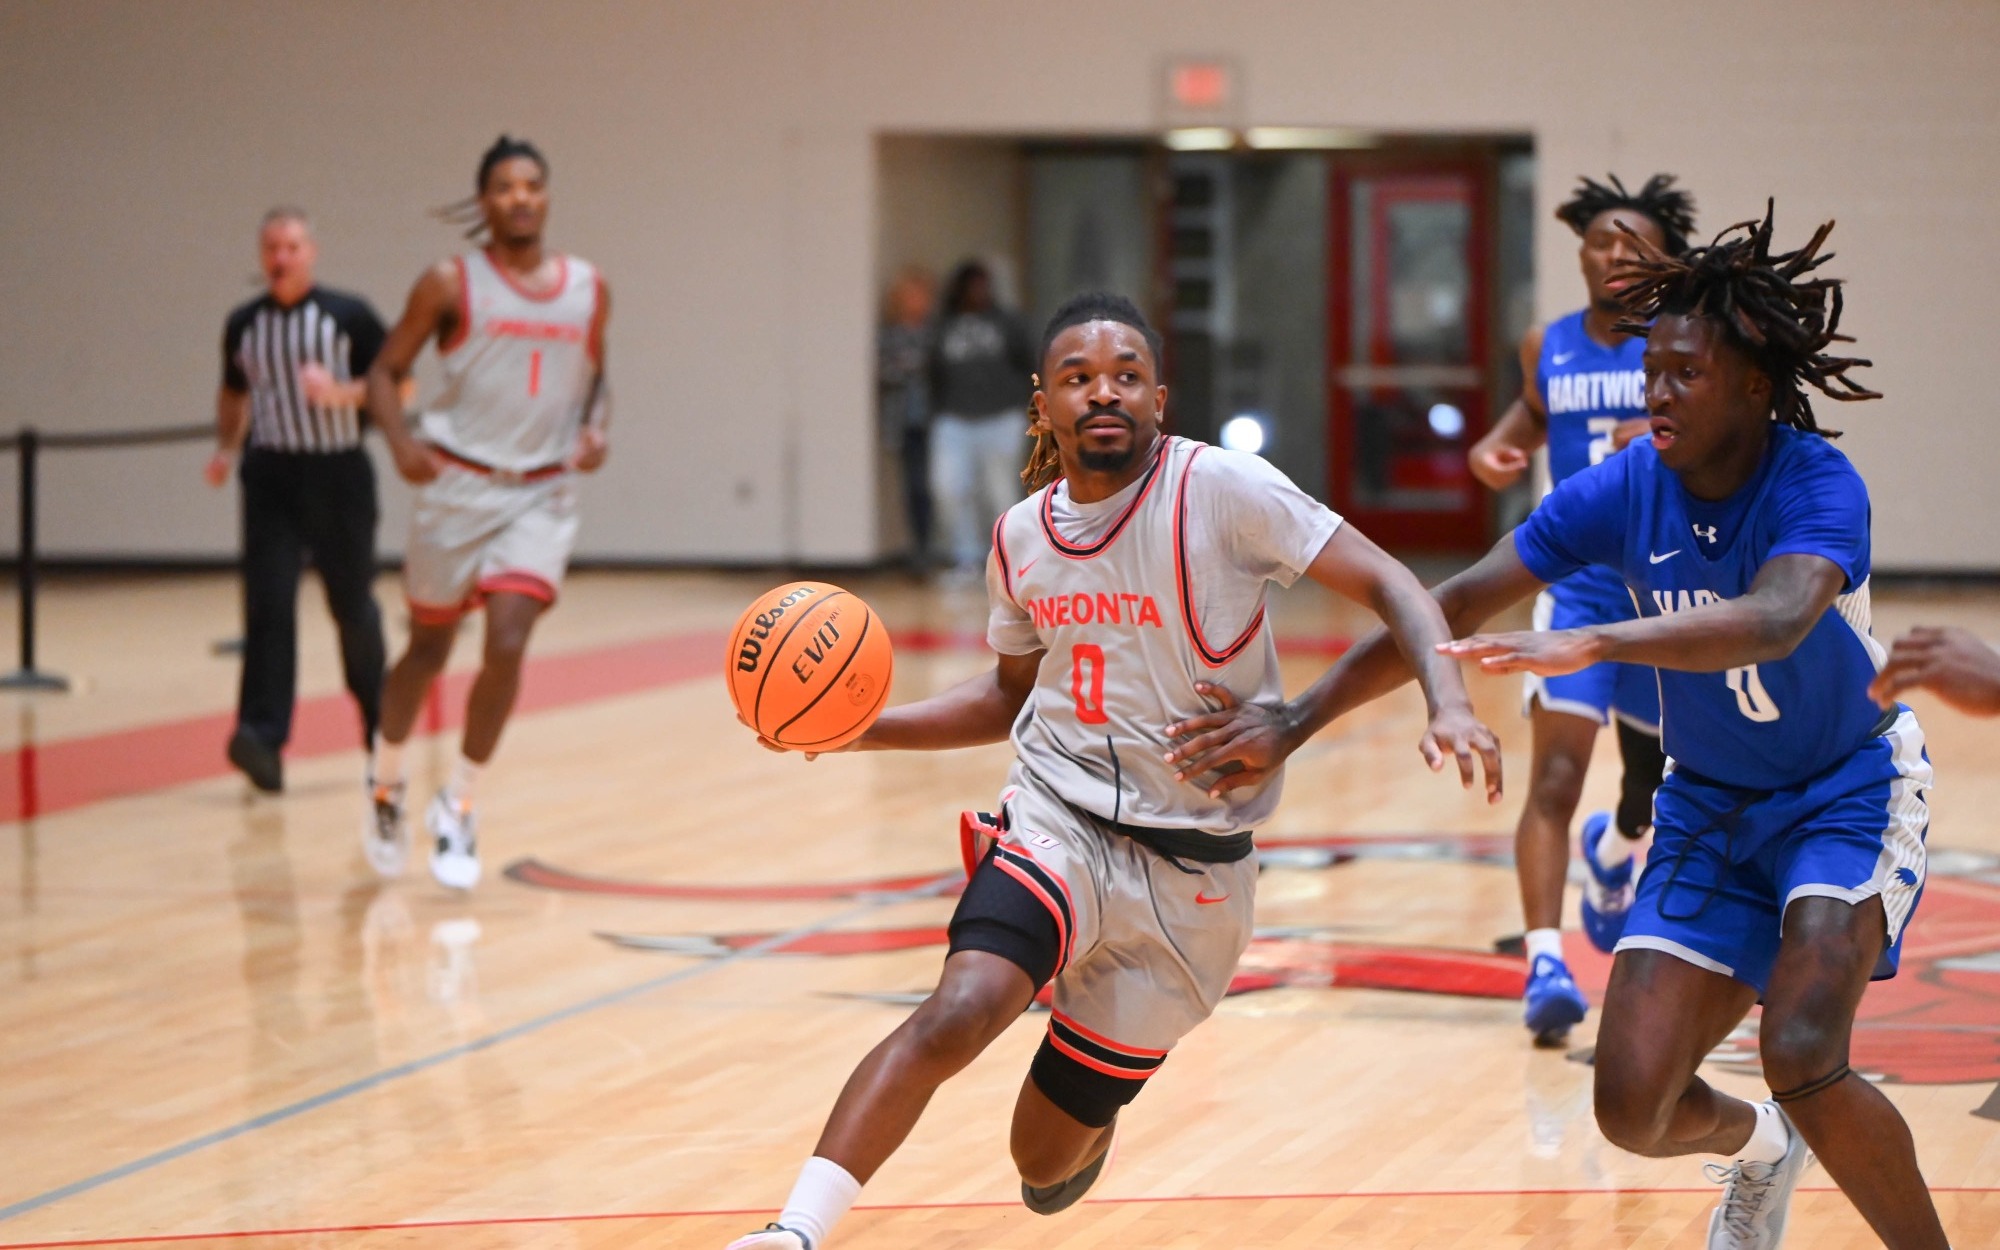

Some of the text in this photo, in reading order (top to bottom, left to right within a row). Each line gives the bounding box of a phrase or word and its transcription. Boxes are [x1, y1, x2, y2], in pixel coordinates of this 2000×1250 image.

[528, 349, 542, 398] 1
[737, 587, 816, 673] Wilson
[1027, 592, 1163, 629] ONEONTA
[1071, 643, 1109, 724] 0
